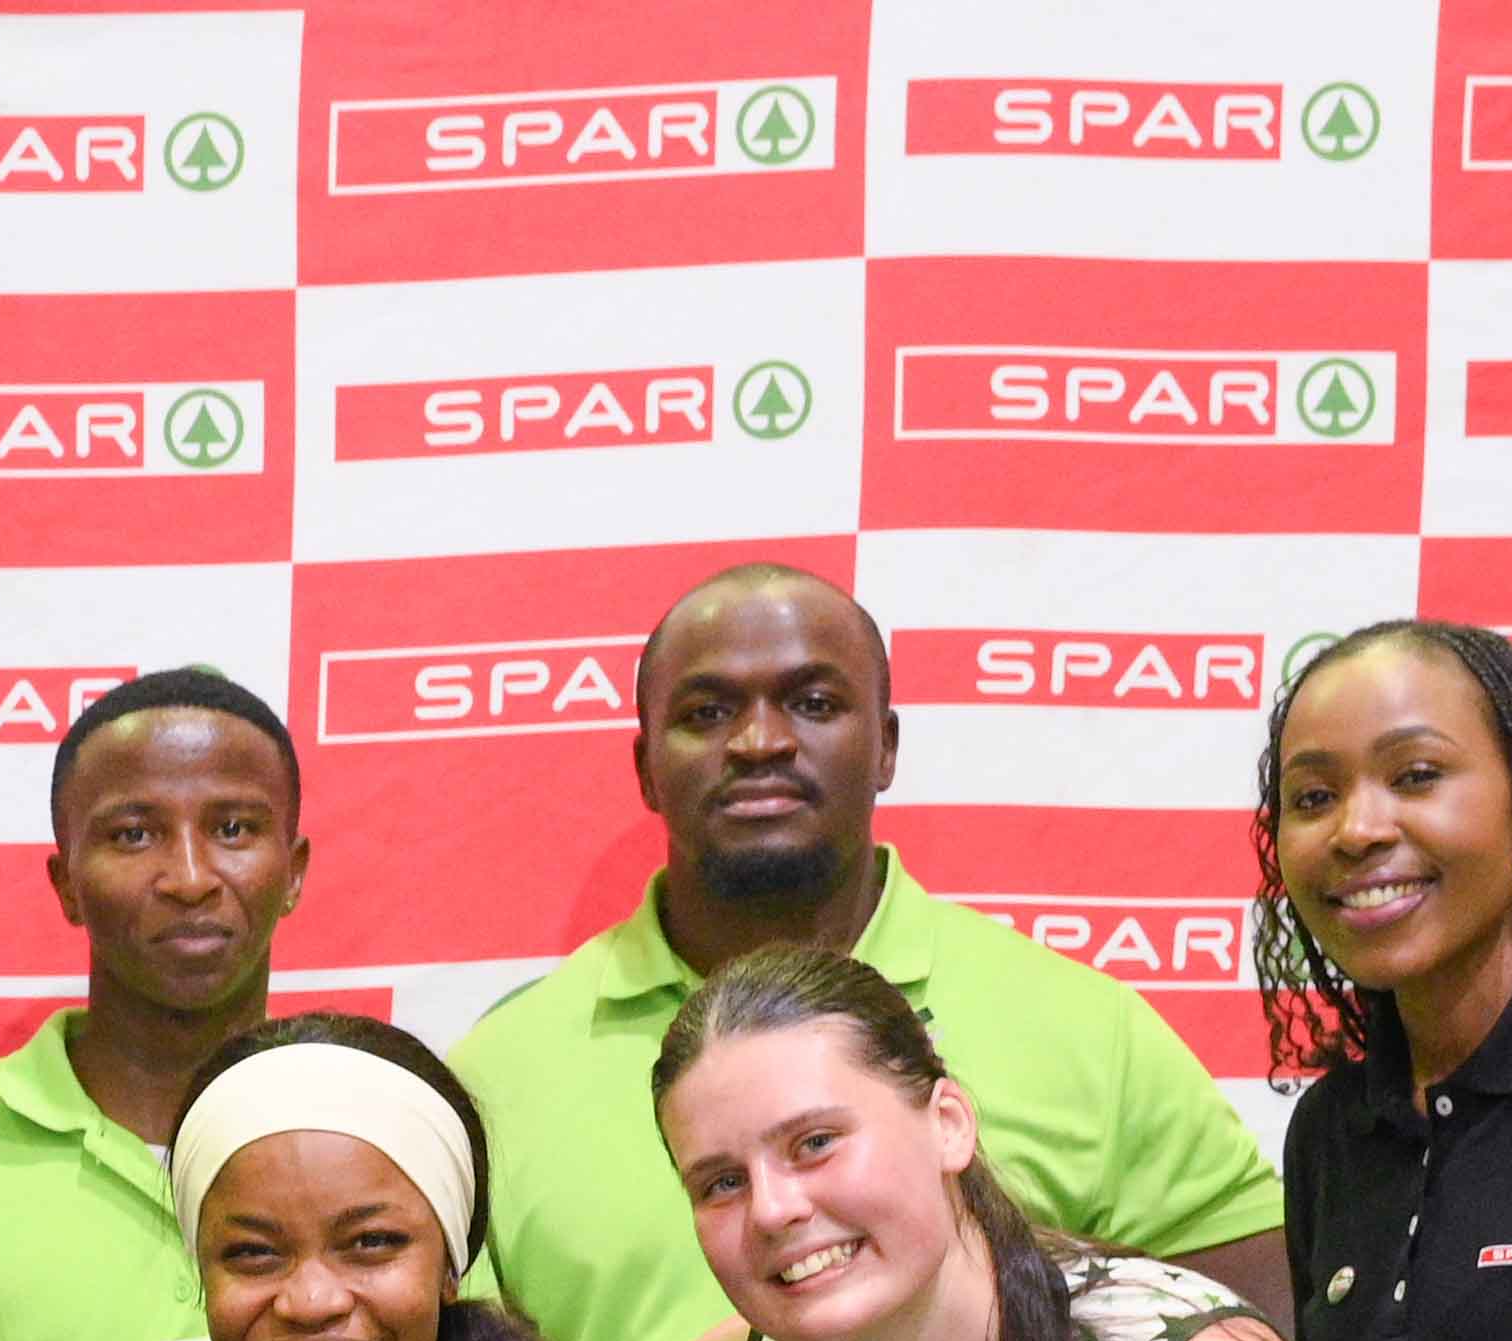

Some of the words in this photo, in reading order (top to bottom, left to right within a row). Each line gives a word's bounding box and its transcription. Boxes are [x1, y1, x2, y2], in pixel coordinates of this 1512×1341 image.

[427, 103, 708, 170] SPAR
[995, 90, 1274, 148] SPAR
[425, 378, 705, 445] SPAR
[991, 366, 1269, 424] SPAR
[414, 656, 640, 721] SPA
[977, 641, 1255, 698] SPAR
[990, 913, 1235, 971] PAR
